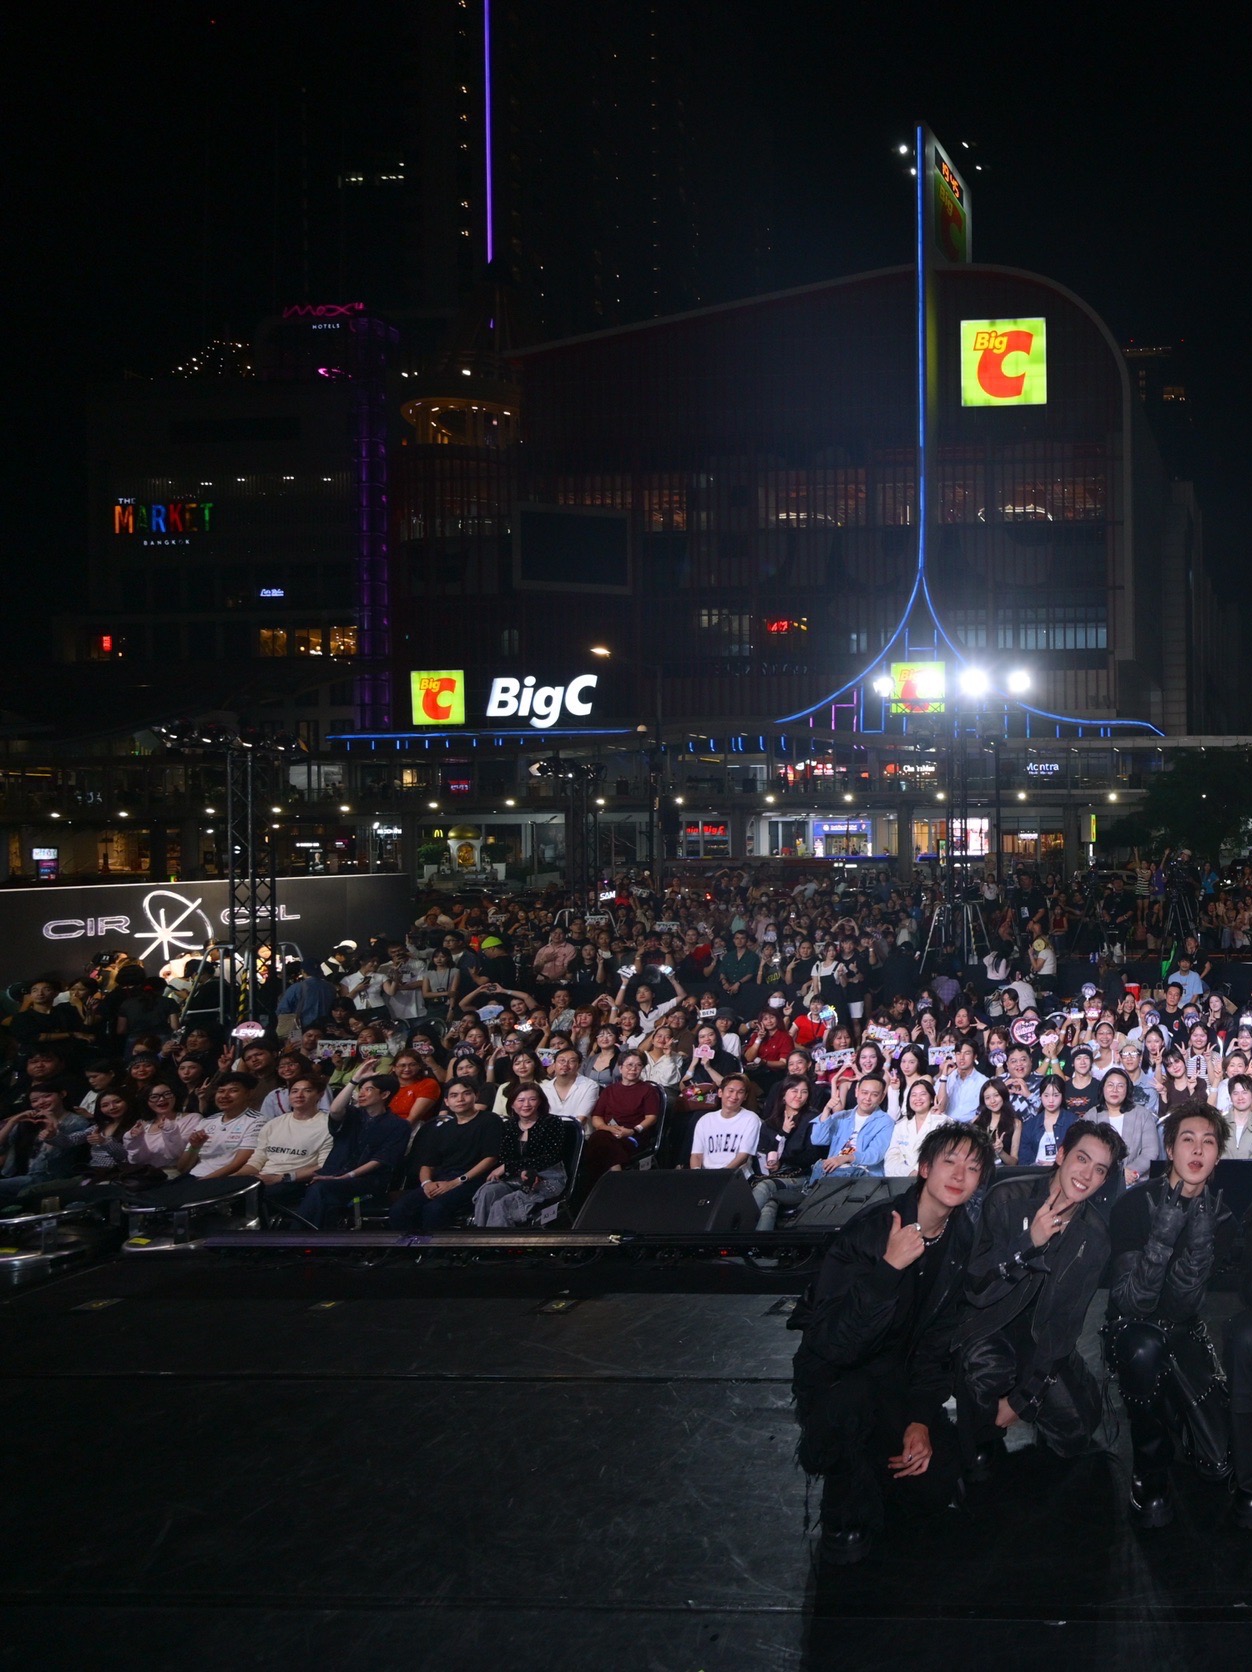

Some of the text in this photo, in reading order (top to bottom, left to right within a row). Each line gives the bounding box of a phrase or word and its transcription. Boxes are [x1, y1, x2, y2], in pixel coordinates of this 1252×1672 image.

[973, 331, 1008, 354] Big
[977, 330, 1034, 399] C
[114, 503, 213, 534] MARKET
[419, 677, 441, 693] Big
[422, 677, 457, 720] C
[486, 674, 598, 729] BigC
[43, 915, 131, 940] CIR
[266, 1145, 308, 1156] SSENTIALS
